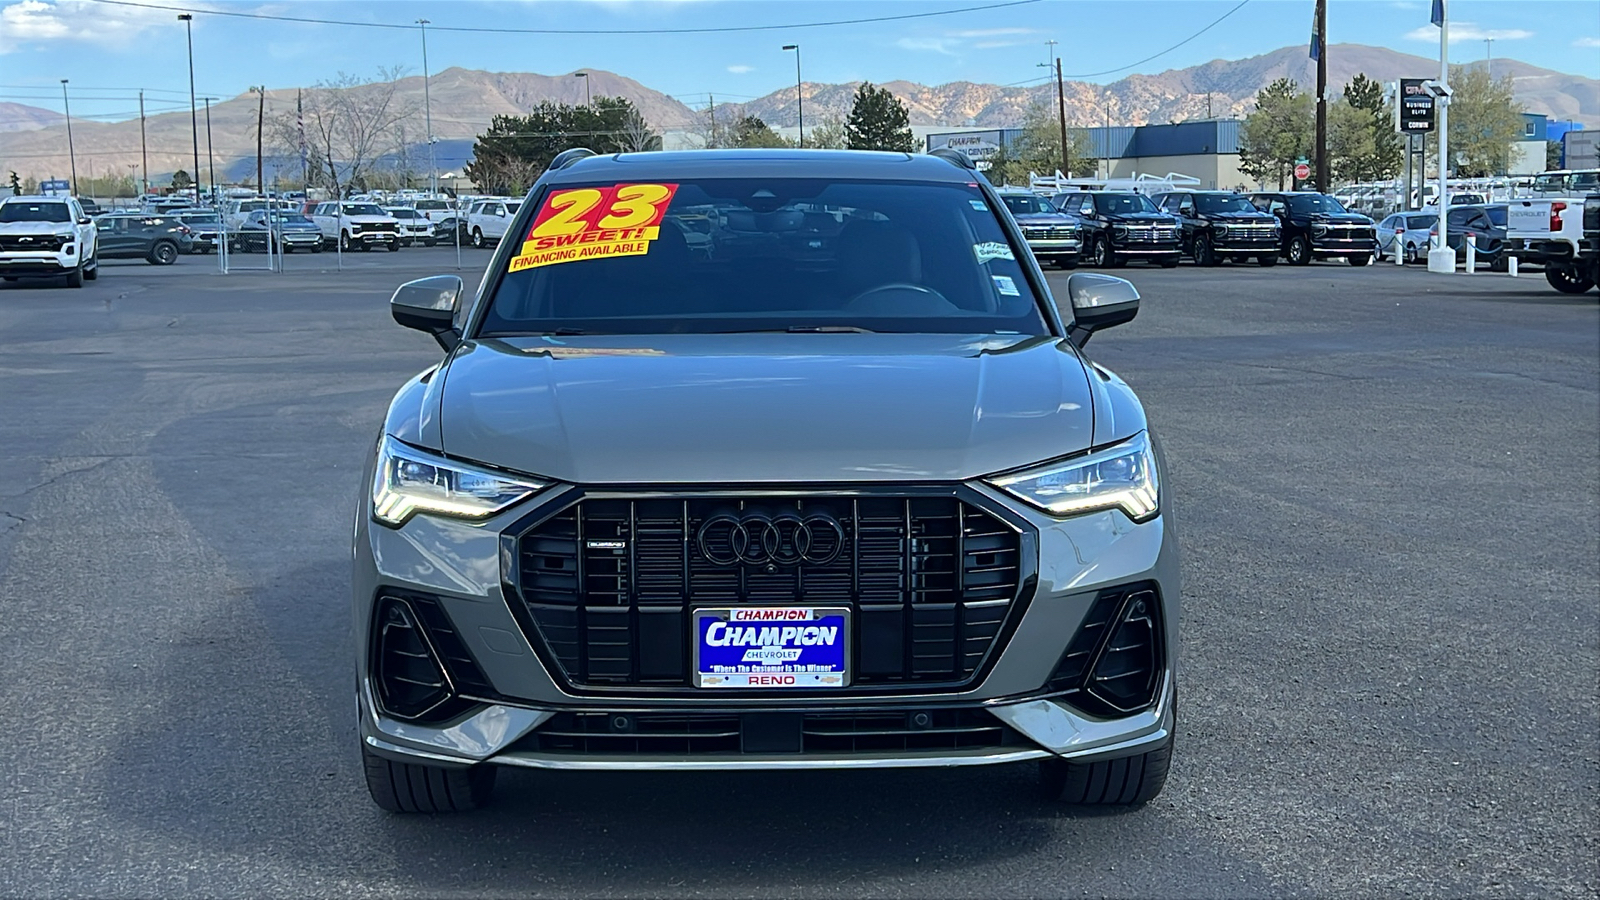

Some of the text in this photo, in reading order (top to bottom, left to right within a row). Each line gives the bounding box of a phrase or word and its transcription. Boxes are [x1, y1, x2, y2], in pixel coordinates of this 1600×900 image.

[947, 136, 981, 149] CHAMPION
[532, 184, 672, 238] 23
[534, 228, 645, 250] SWEET!
[513, 242, 645, 268] FINANCING AVAILABLE
[736, 610, 808, 621] CHAMPION
[705, 621, 838, 646] CHAMPION
[746, 651, 798, 659] CHEVROLET
[738, 665, 750, 673] The
[751, 665, 784, 673] Customer
[748, 676, 795, 685] RENO
